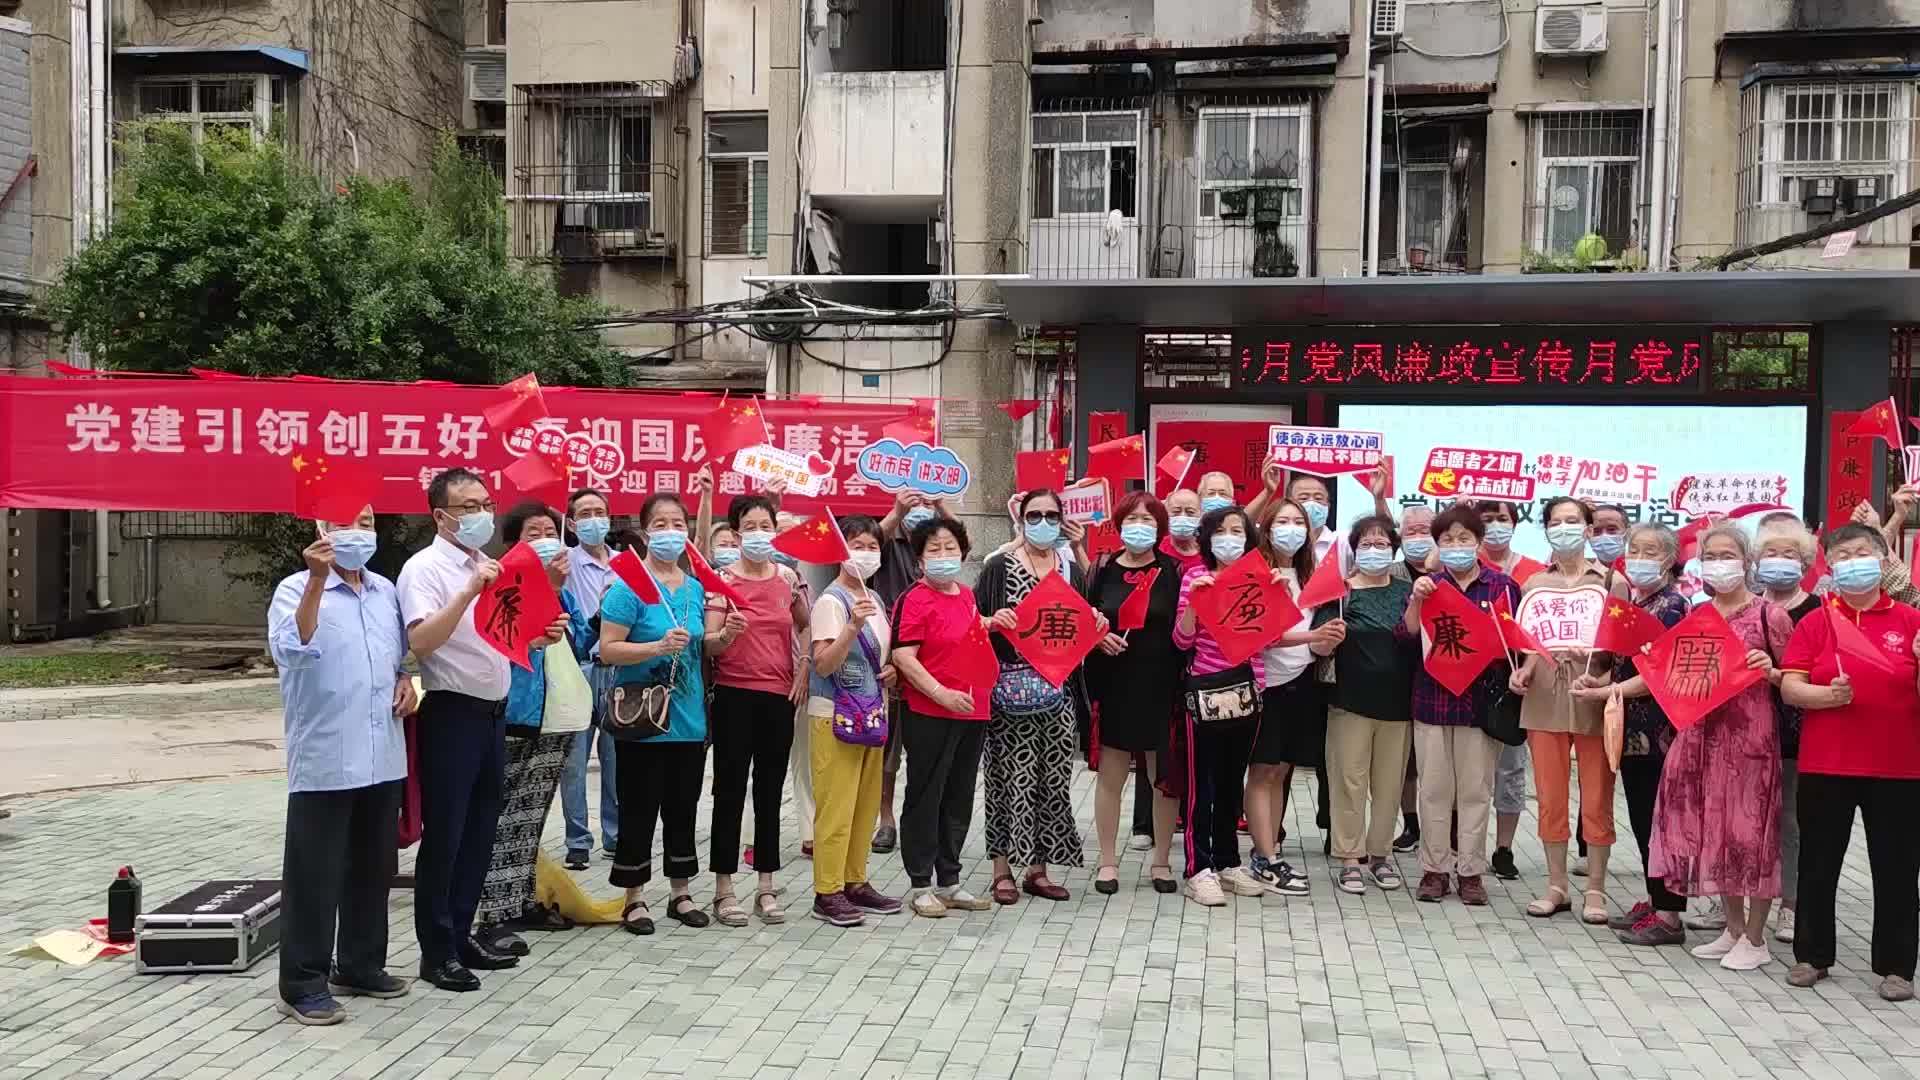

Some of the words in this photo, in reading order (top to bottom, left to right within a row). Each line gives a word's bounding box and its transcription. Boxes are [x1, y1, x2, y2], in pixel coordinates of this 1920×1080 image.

[65, 402, 488, 460] 党建引领创五好
[1276, 431, 1379, 449] 使命永远放心间
[594, 458, 615, 472] 力行
[869, 452, 912, 478] 好市民
[919, 461, 961, 485] 讲文明
[1430, 450, 1517, 473] 志愿者之城
[1537, 454, 1573, 470] 撸起
[1457, 475, 1529, 497] 众志成城
[1536, 470, 1571, 485] 袖子
[1569, 459, 1657, 502] 加油干
[1531, 597, 1588, 618] 我爱你
[1018, 603, 1081, 649] 廉
[1430, 610, 1479, 661] 廉
[1532, 620, 1579, 642] 祖国
